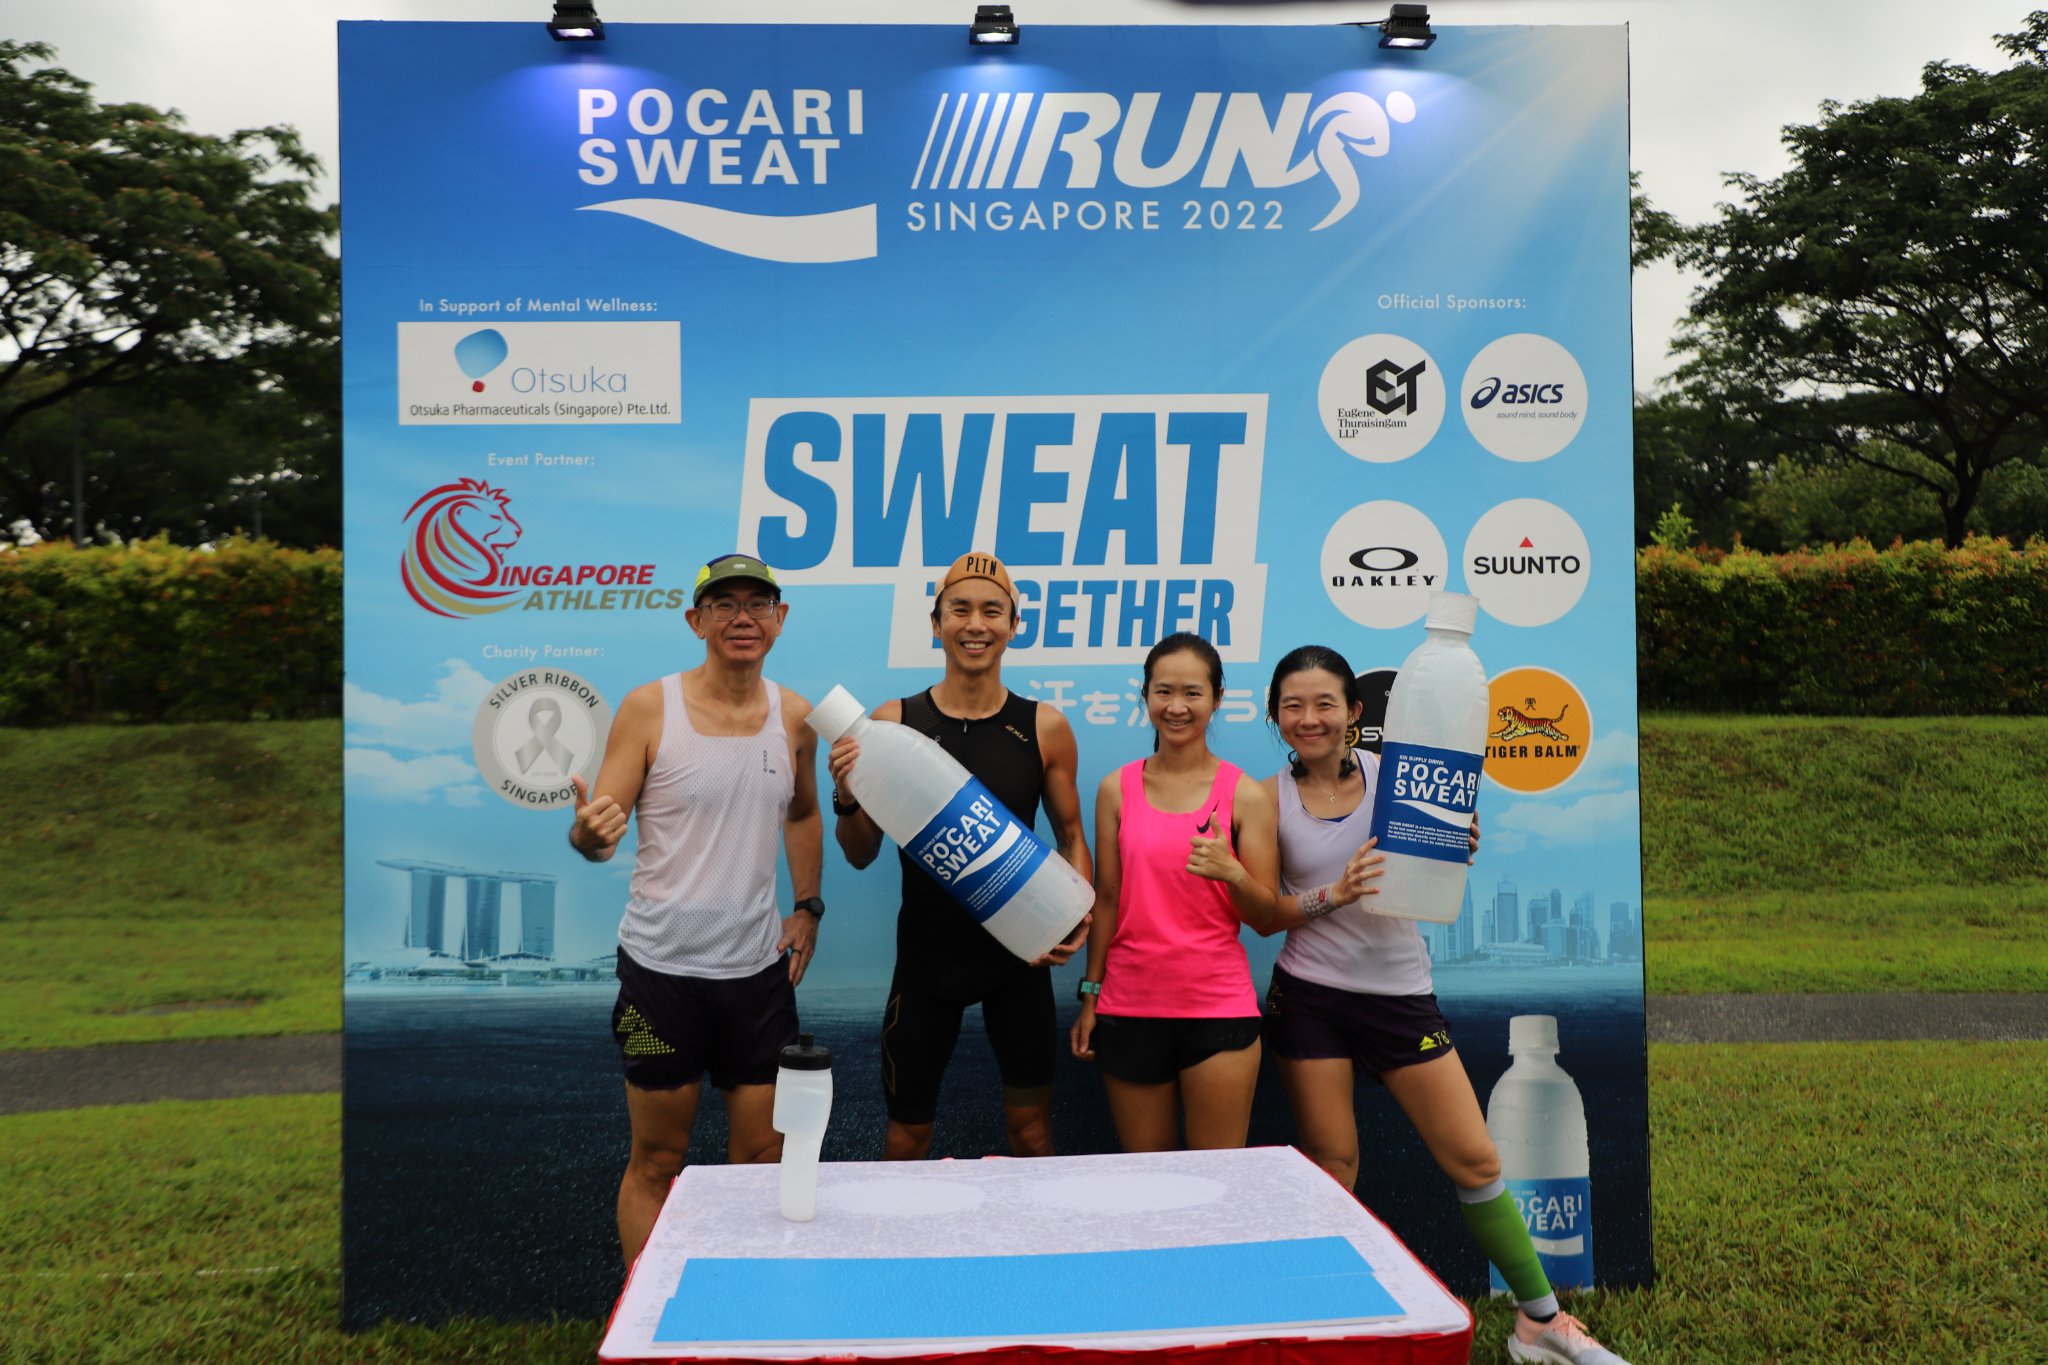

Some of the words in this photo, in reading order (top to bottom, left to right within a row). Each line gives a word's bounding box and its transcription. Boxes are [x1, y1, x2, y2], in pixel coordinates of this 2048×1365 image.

[578, 88, 863, 135] POCARI
[1012, 92, 1320, 189] RUN
[578, 138, 840, 185] SWEAT
[907, 200, 1160, 231] SINGAPORE
[1183, 200, 1283, 230] 2022
[419, 299, 432, 312] In
[439, 298, 501, 316] Support
[505, 298, 522, 312] of
[527, 298, 581, 312] Mental
[586, 297, 658, 312] Wellness:
[1377, 294, 1439, 309] Official
[1446, 295, 1527, 312] Sponsors:
[511, 366, 627, 393] Otsuka
[410, 404, 450, 416] Otsuka
[453, 402, 550, 416] Pharmaceuticals
[554, 401, 623, 418] (Singapore)
[1337, 408, 1375, 419] Eugene
[1497, 411, 1518, 419] sound
[1538, 411, 1559, 419] sound
[1560, 411, 1577, 420] body
[1337, 418, 1407, 428] Thuraisingam
[1338, 429, 1359, 439] LLP
[487, 453, 529, 466] Event
[535, 452, 595, 466] Partner:
[757, 411, 1247, 570] SWEAT
[967, 556, 997, 576] PLTN
[1473, 555, 1580, 575] SUUNTO
[1332, 575, 1436, 587] OAKLEY
[522, 588, 684, 611] ATHLETICS
[482, 644, 537, 661] Charity
[544, 644, 605, 657] Partner:
[490, 673, 538, 709] SILVER
[545, 672, 599, 708] RIBBON
[1484, 745, 1528, 758] TIGER
[1534, 745, 1577, 758] BALM
[1393, 778, 1476, 808] SWEAT
[922, 794, 993, 869] POCARI
[936, 810, 1001, 881] SWEAT
